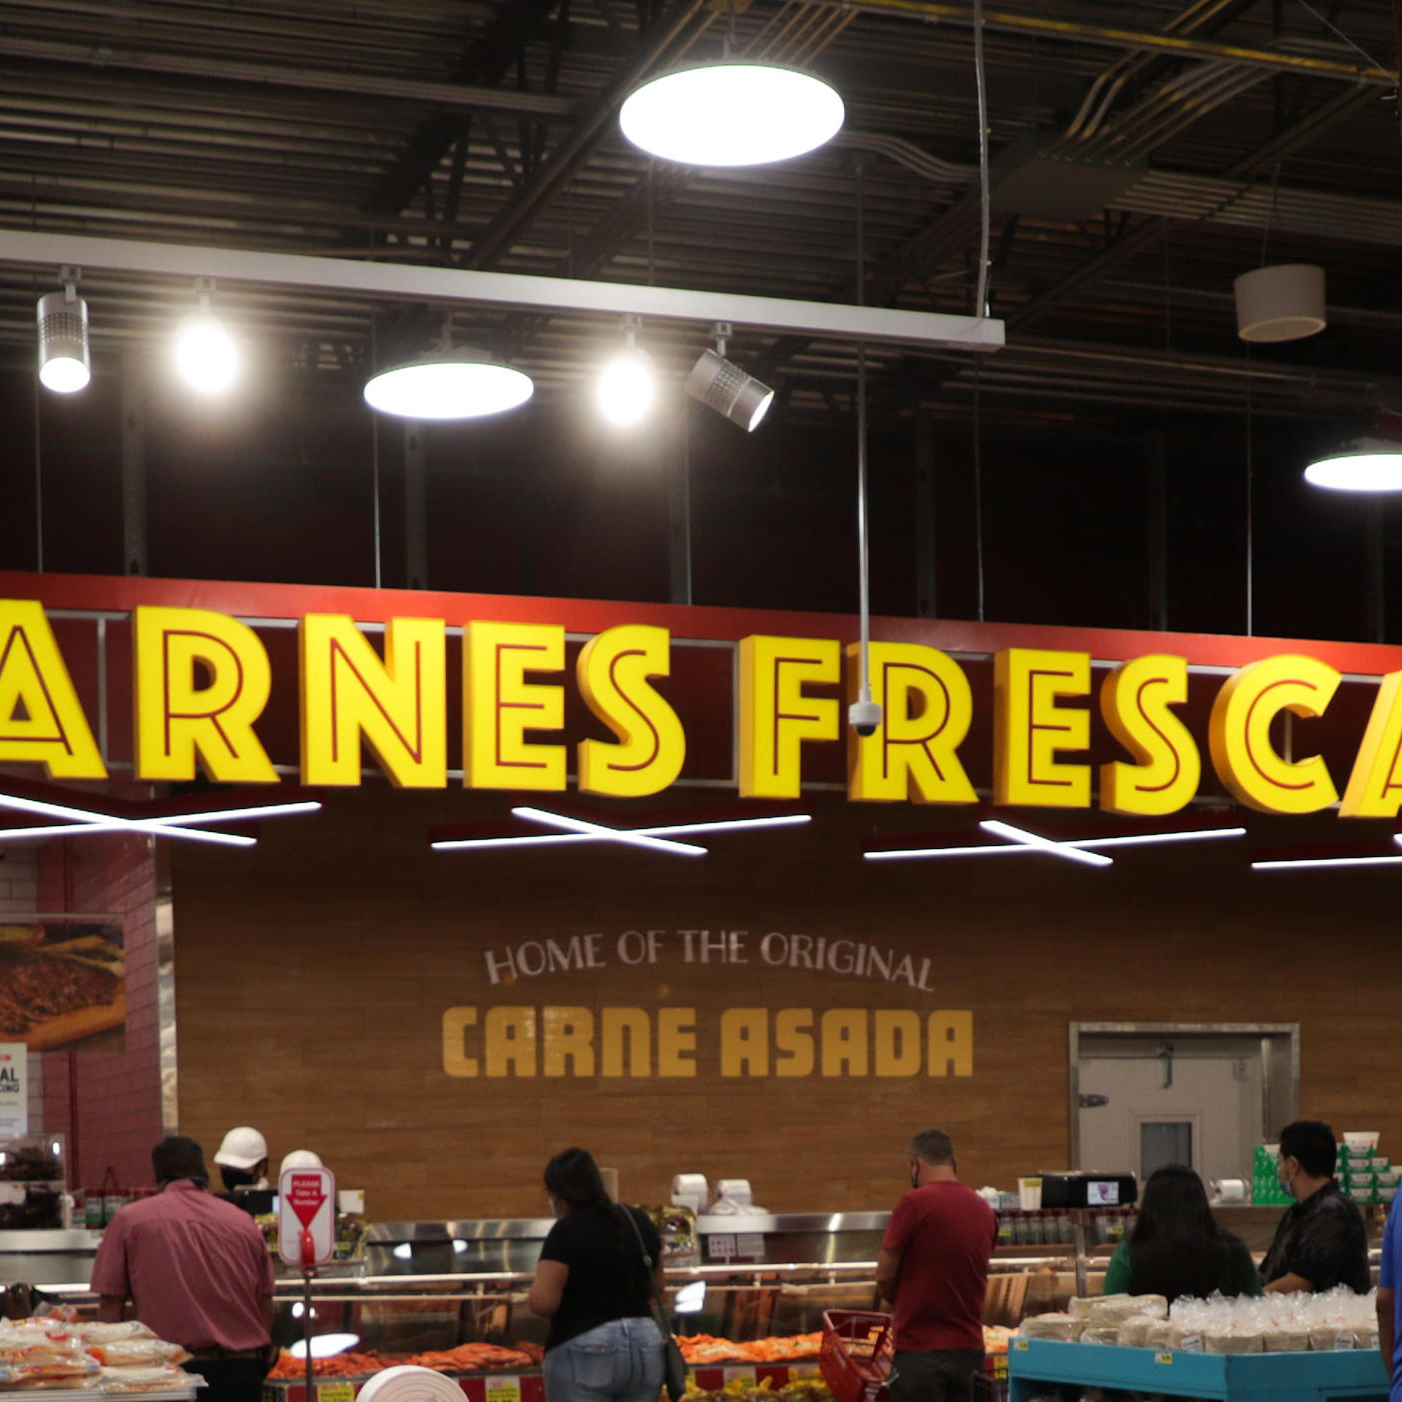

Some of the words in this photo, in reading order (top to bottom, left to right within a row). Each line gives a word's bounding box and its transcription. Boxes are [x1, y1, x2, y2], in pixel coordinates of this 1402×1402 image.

[484, 934, 606, 984] HOME
[616, 931, 665, 964] OF
[678, 930, 748, 963] THE
[760, 932, 935, 992] ORIGINAL
[441, 1005, 698, 1080] CARNE
[720, 1007, 975, 1079] ASADA
